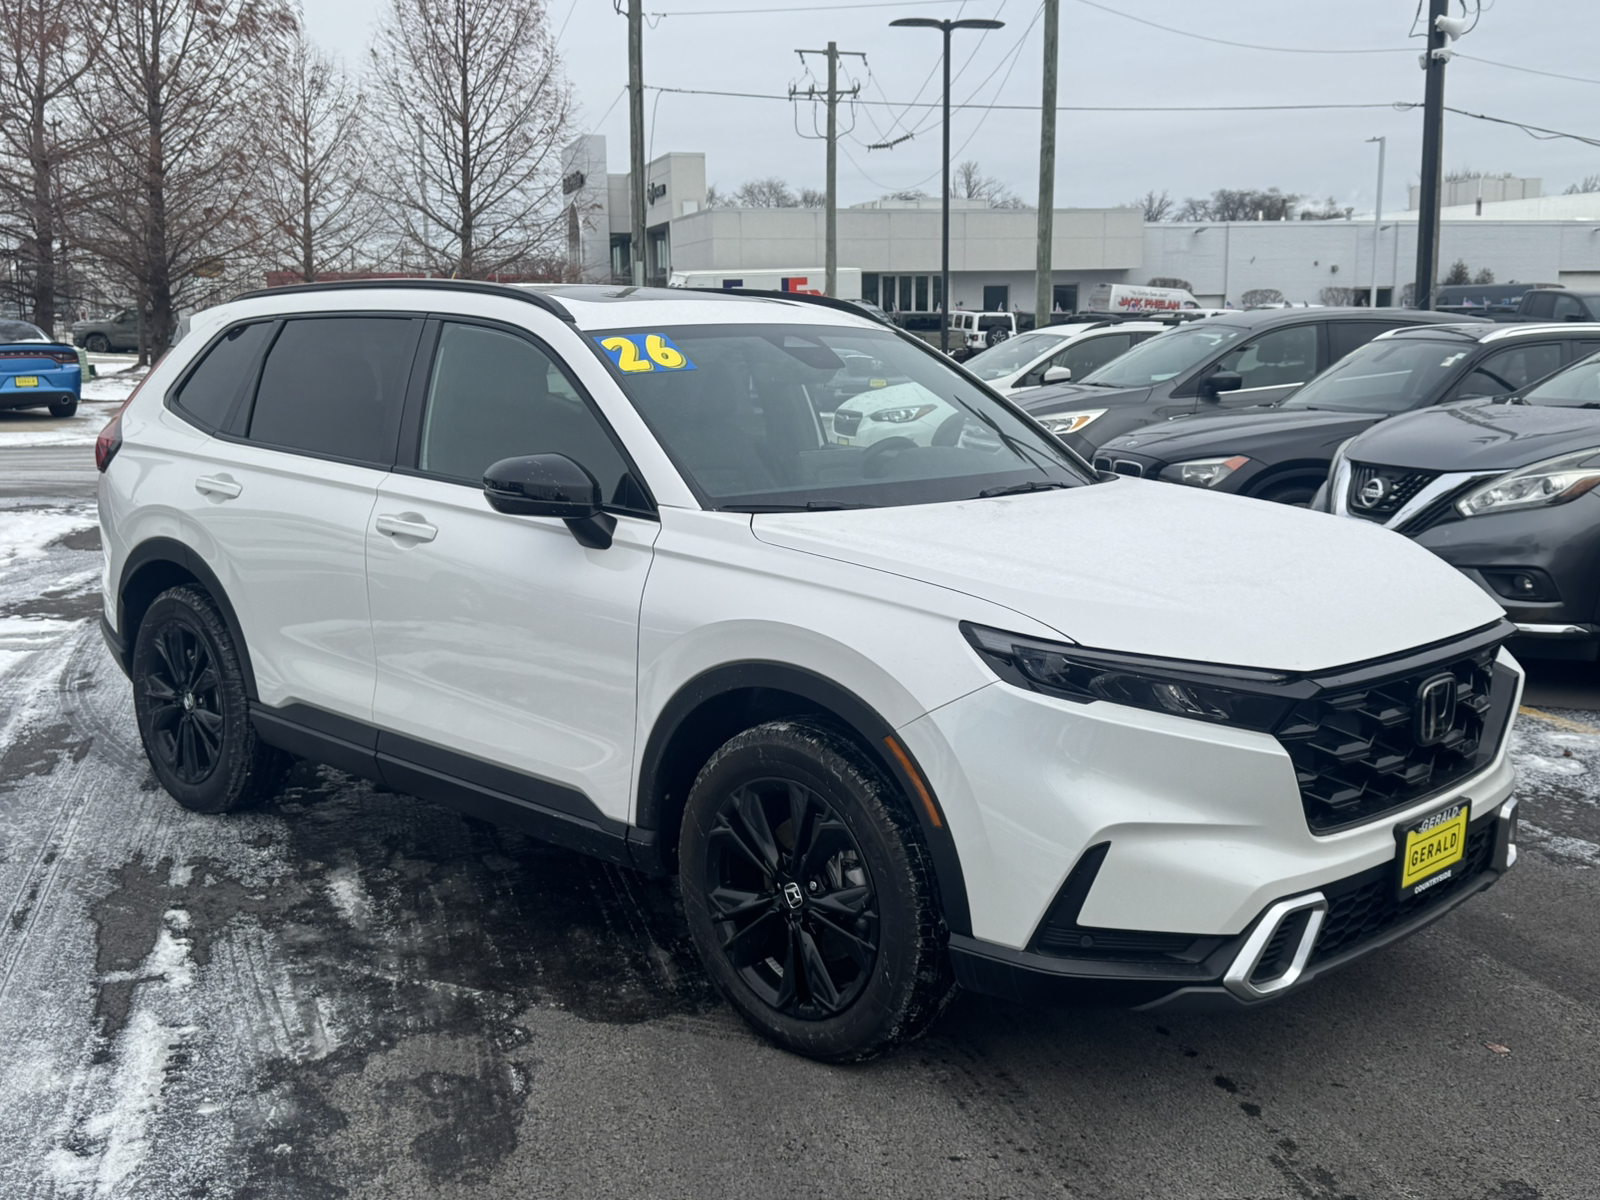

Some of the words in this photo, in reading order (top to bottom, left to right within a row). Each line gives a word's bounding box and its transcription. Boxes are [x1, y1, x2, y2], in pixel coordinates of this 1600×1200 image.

[1144, 298, 1180, 310] PHELAN
[601, 334, 687, 372] 26
[1411, 832, 1457, 867] GERALD
[1414, 869, 1452, 894] COUNTRYSIDE
